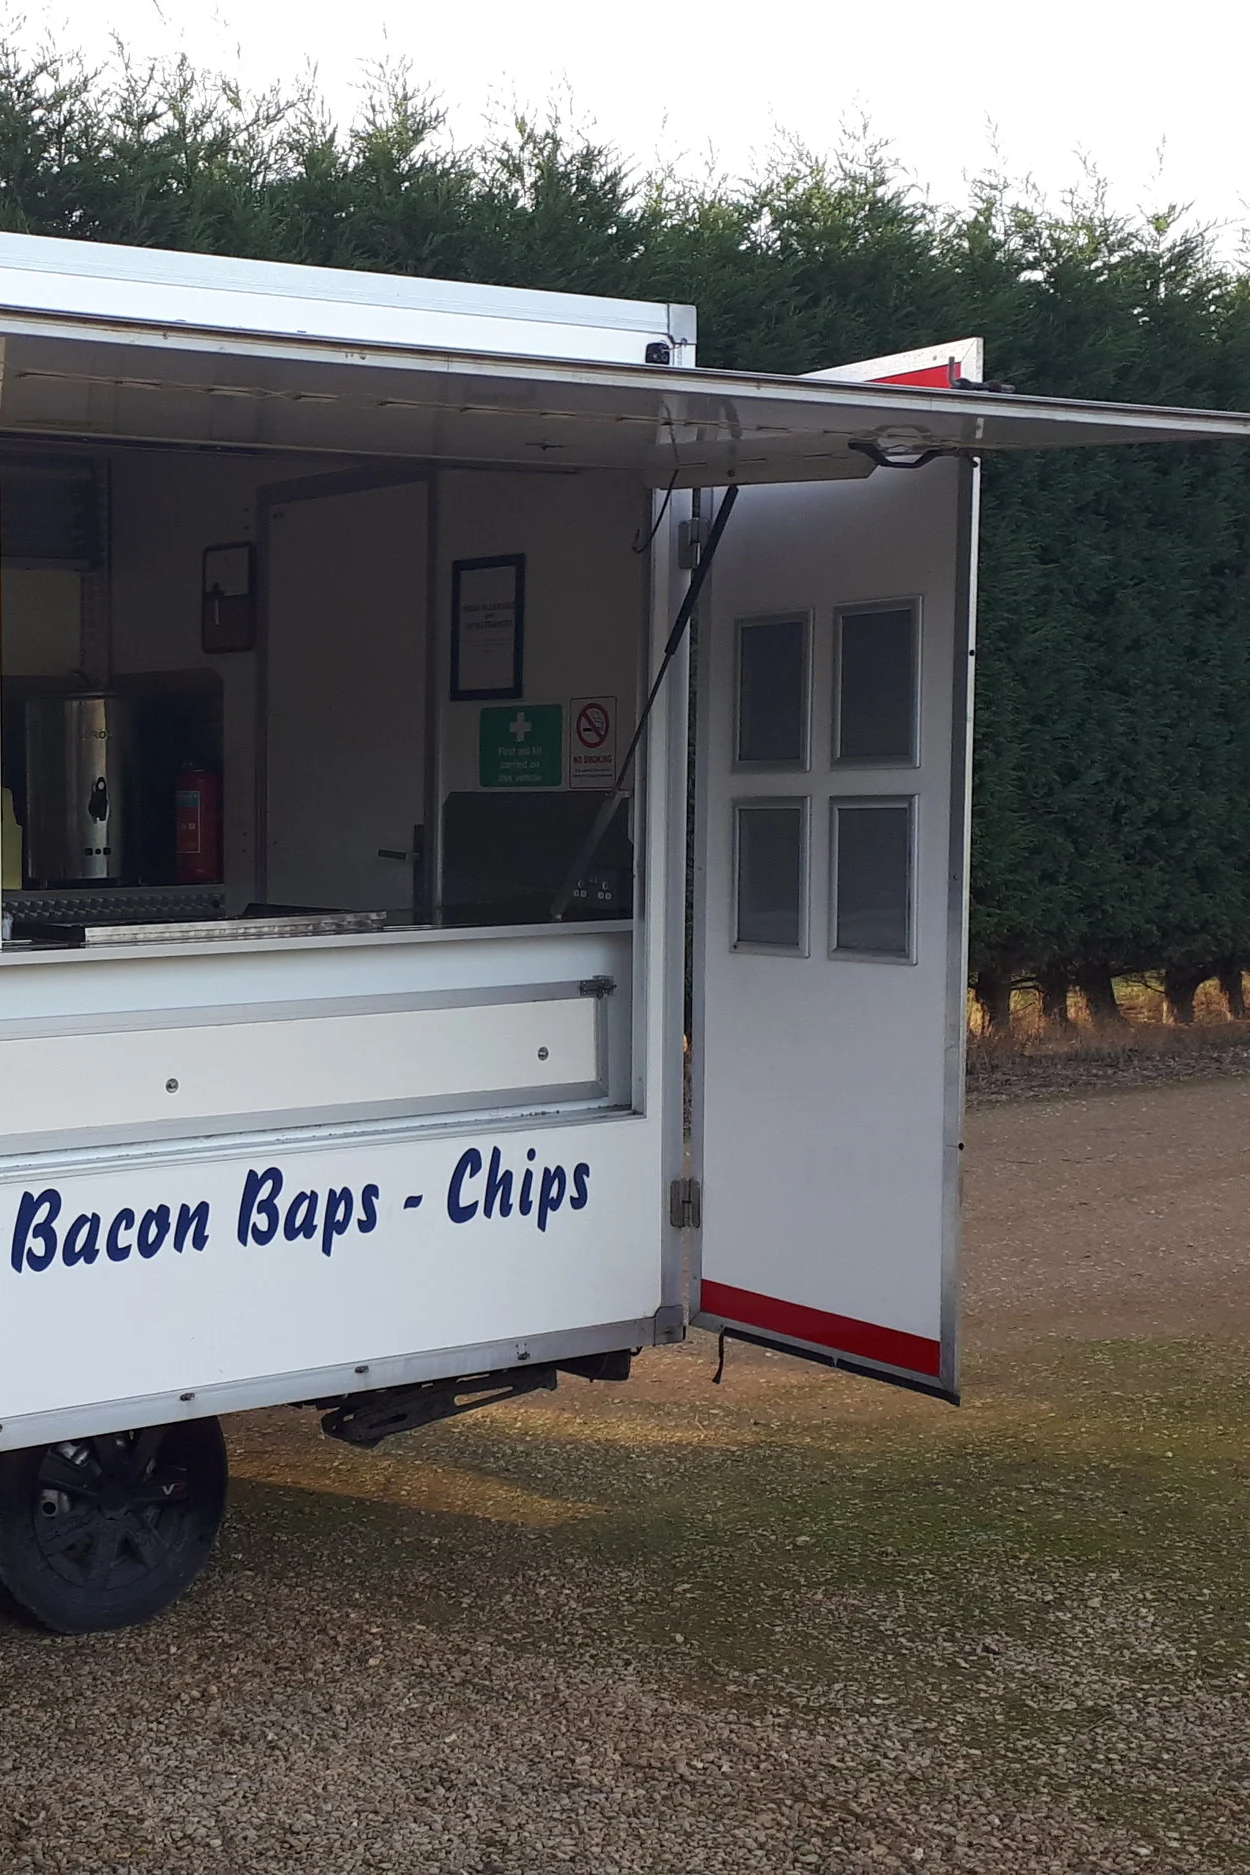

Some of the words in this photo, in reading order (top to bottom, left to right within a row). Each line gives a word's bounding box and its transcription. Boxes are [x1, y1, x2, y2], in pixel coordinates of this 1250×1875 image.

[573, 755, 582, 764] NO
[583, 755, 613, 764] SMOKING
[10, 1188, 211, 1273] Bacon
[236, 1166, 380, 1257] Baps
[446, 1145, 591, 1232] Chips
